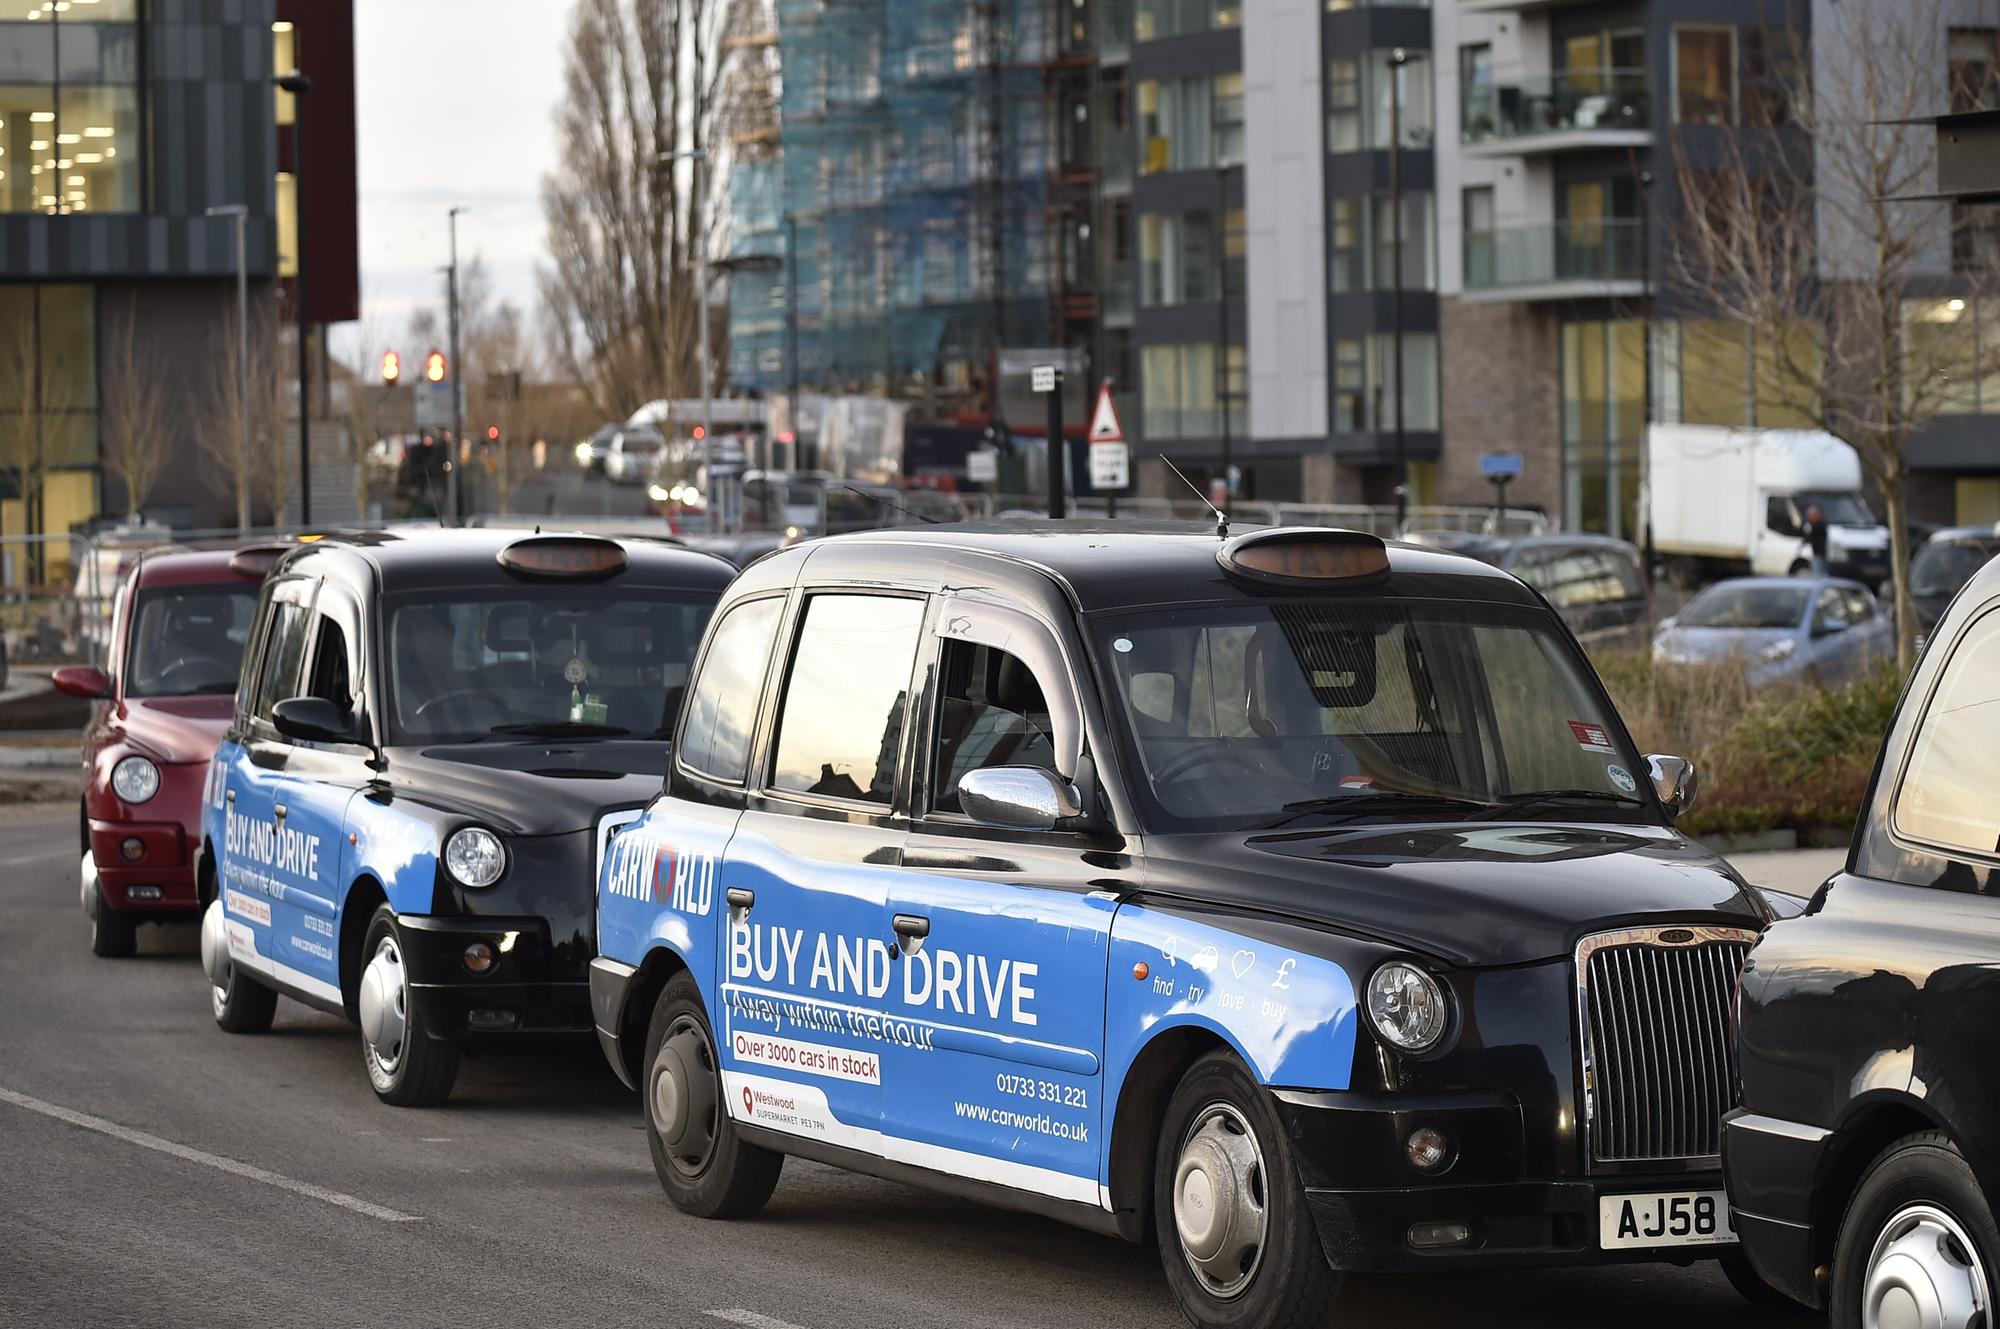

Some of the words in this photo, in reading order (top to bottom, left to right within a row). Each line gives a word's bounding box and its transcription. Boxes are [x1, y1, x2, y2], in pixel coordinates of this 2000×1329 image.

[1278, 543, 1364, 574] TAXI
[226, 811, 249, 857] BUY
[249, 817, 276, 865] AND
[275, 827, 320, 881] DRIVE
[608, 832, 715, 917] CARWORLD
[731, 921, 804, 986] BUY
[809, 931, 892, 999] AND
[903, 947, 1040, 1026] DRIVE
[733, 989, 783, 1033] Away
[782, 998, 846, 1035] within
[845, 1005, 882, 1041] the
[880, 1010, 935, 1052] hour
[1152, 975, 1175, 997] find
[1187, 983, 1205, 1005] try
[1217, 988, 1245, 1011] love
[1261, 997, 1288, 1023] buy
[735, 1034, 766, 1056] Over
[767, 1042, 797, 1064] 3000
[799, 1050, 825, 1070] cars
[827, 1050, 840, 1072] in
[841, 1052, 878, 1079] stock
[753, 1090, 796, 1111] Westwood
[996, 1073, 1036, 1098] 01733
[1038, 1082, 1061, 1103] 331
[1064, 1086, 1089, 1109] 221
[756, 1109, 799, 1126] SUPERMARKET
[800, 1117, 813, 1128] PE3
[813, 1119, 825, 1131] 7PN
[955, 1100, 1089, 1143] www.carworld.co.uk
[1617, 1196, 1716, 1239] AJ58
